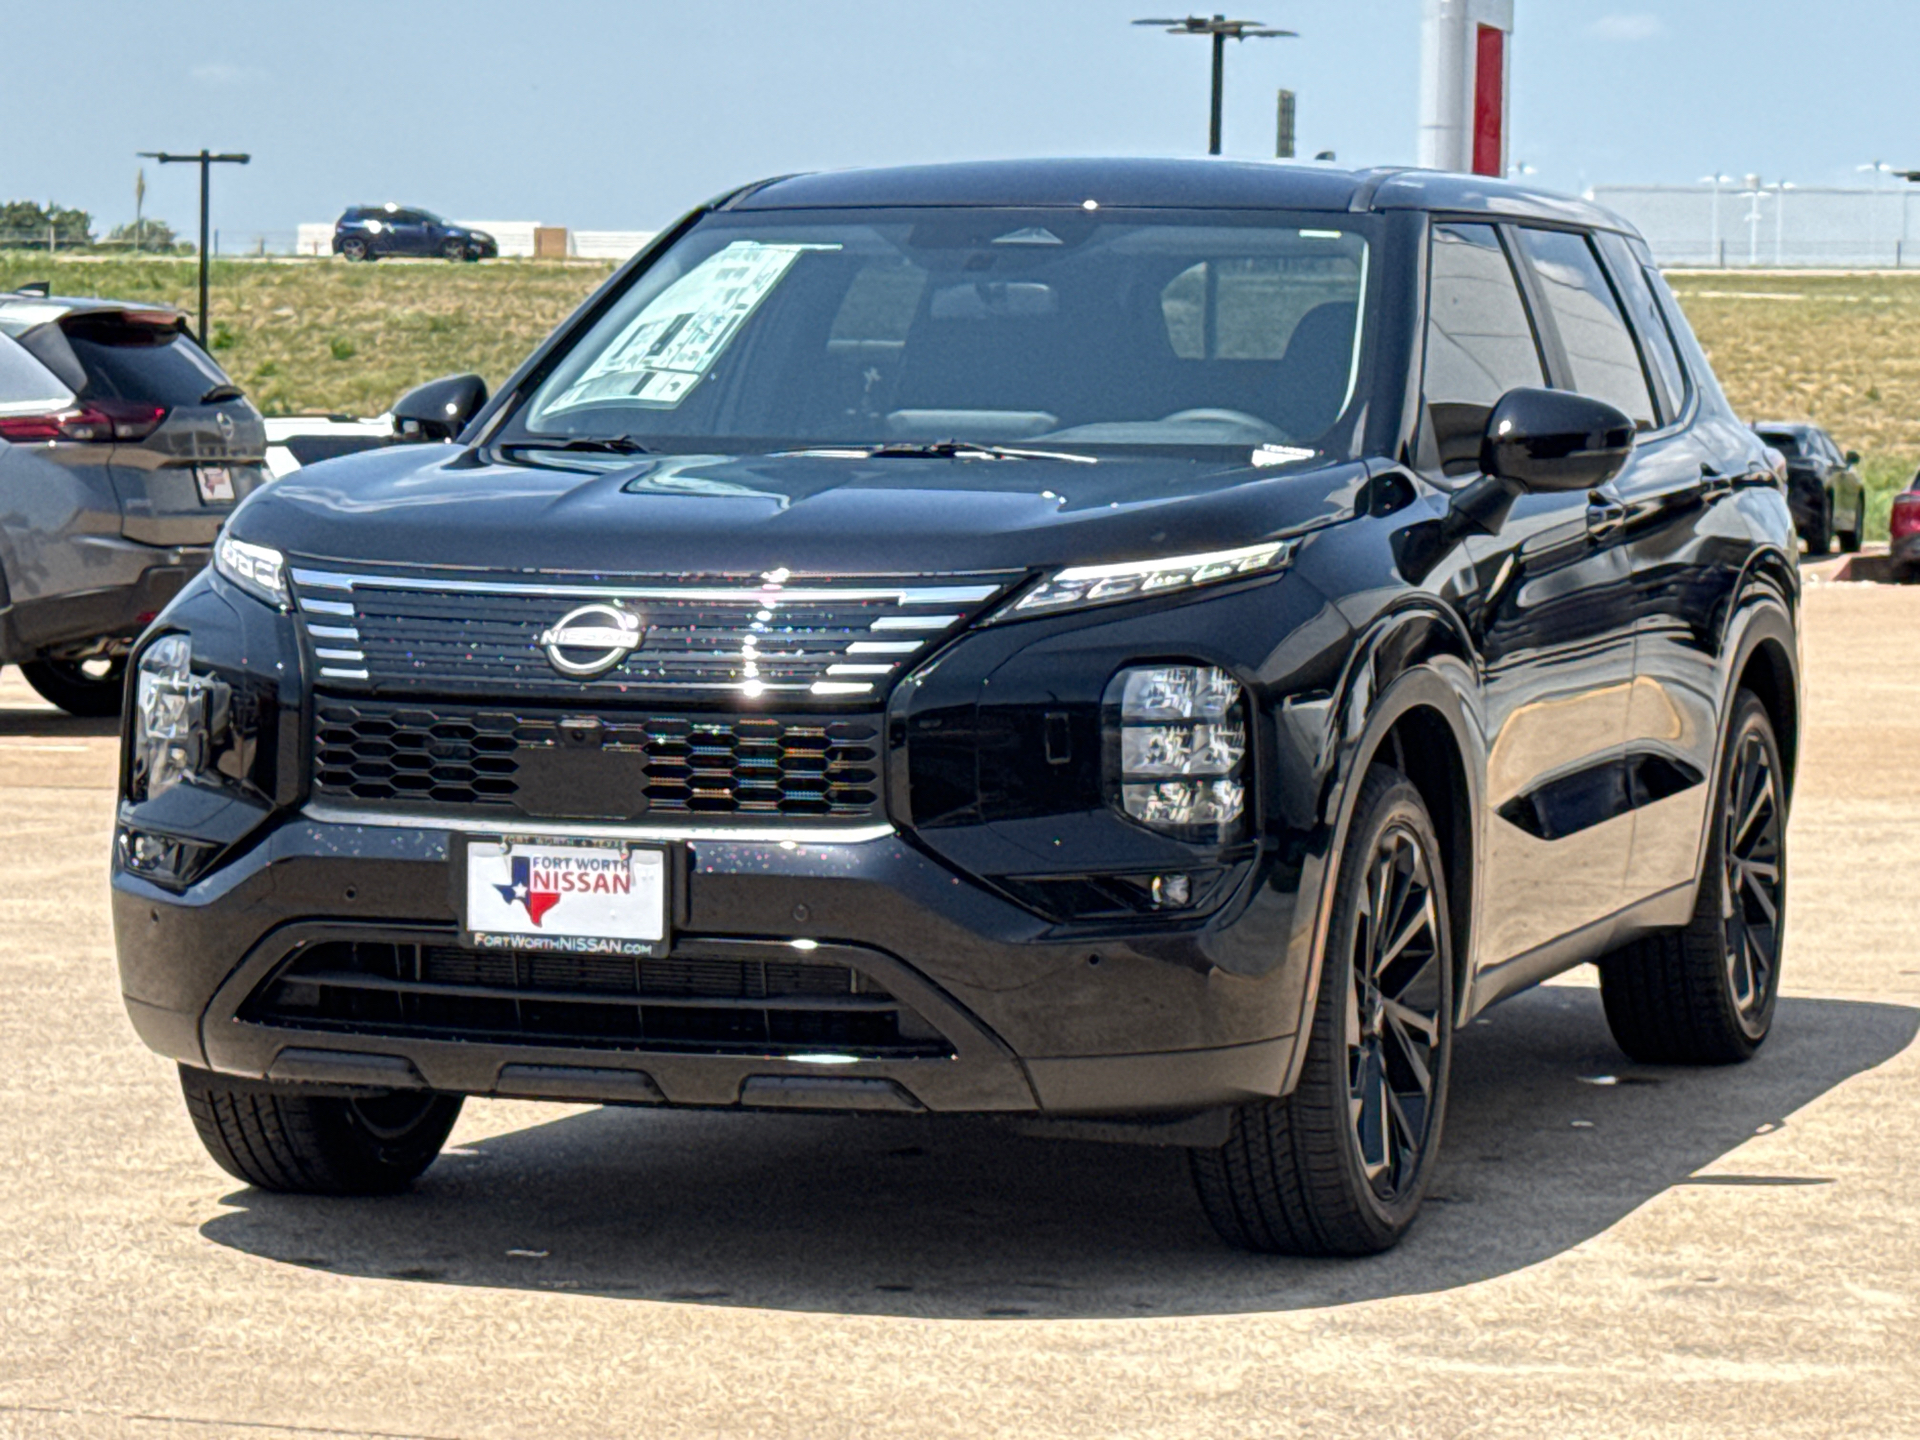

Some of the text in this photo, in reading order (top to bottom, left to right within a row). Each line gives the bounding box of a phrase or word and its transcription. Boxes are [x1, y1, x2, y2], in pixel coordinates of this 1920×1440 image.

[532, 856, 631, 873] FORT WORTH
[533, 870, 631, 895] NISSAN
